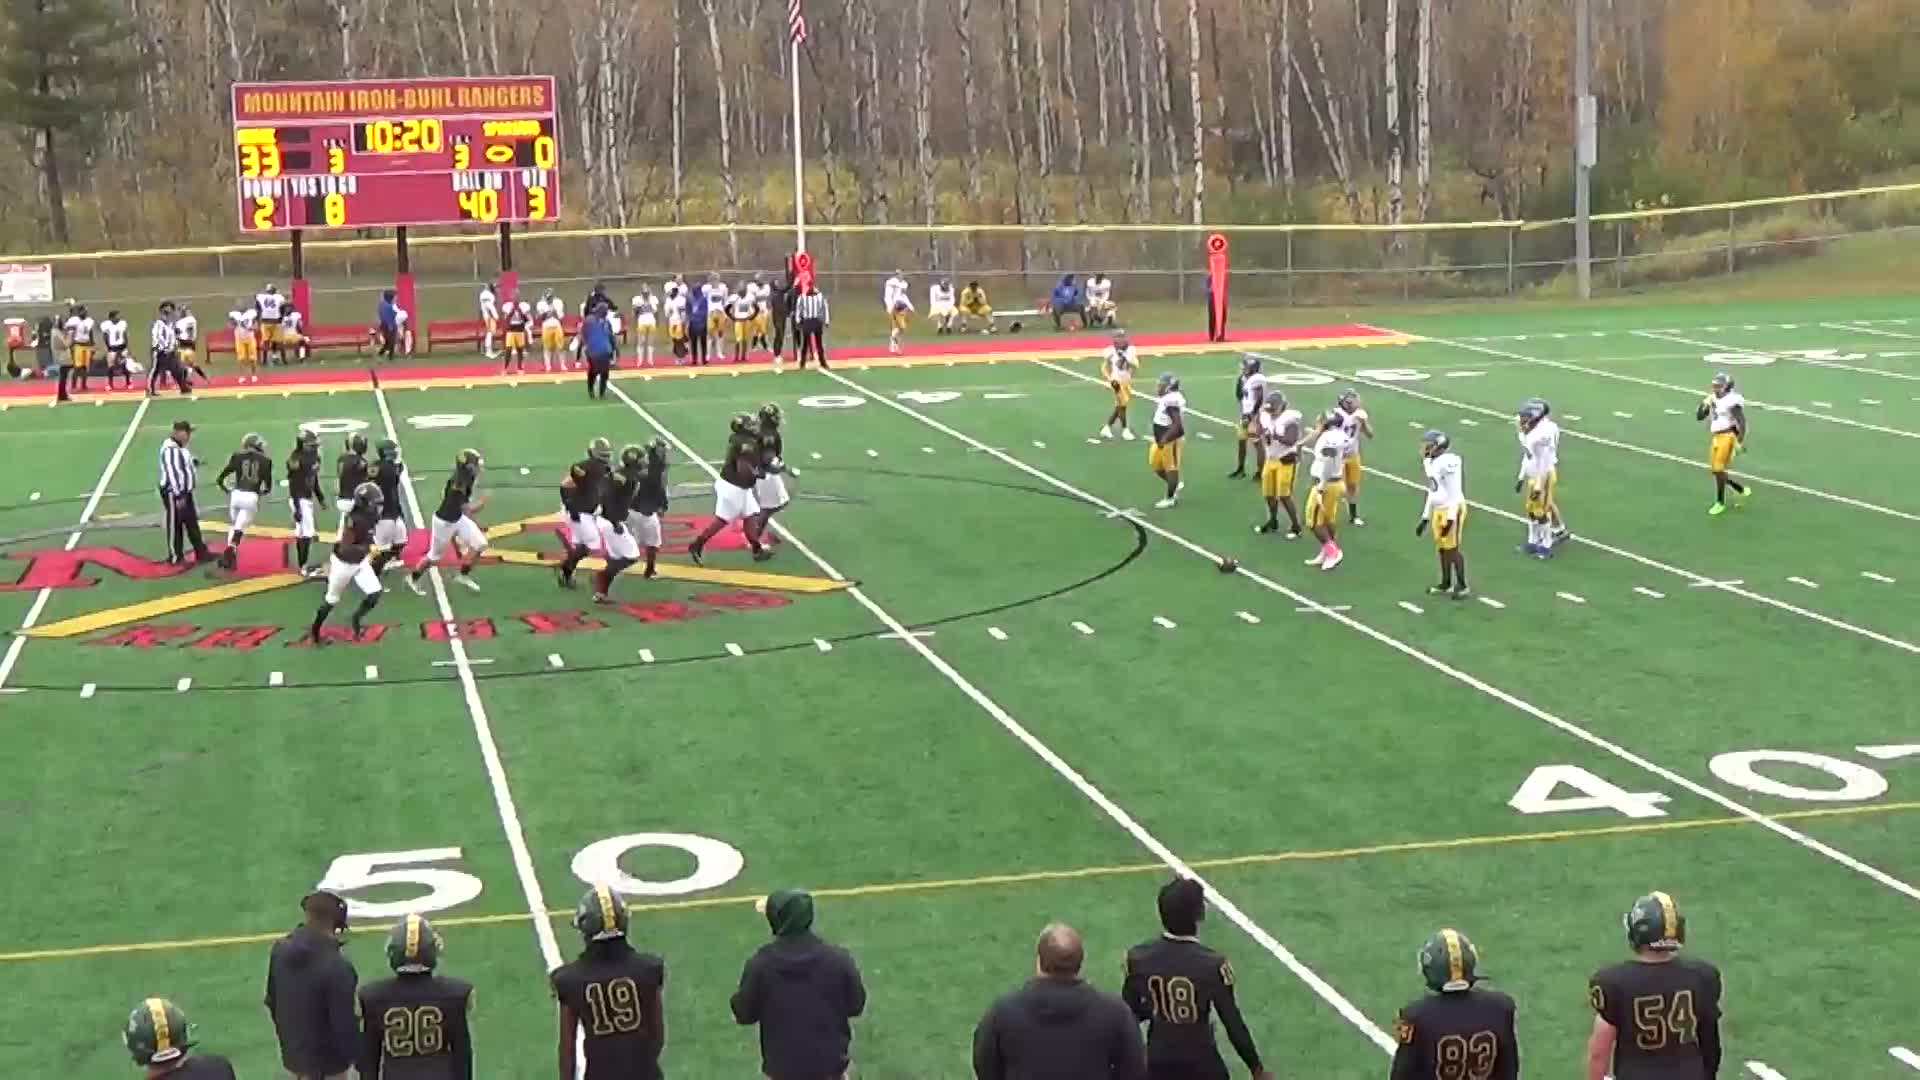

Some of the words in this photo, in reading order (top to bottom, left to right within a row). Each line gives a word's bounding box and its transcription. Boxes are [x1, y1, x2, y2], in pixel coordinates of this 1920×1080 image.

[243, 91, 345, 113] MOUNTAIN
[458, 85, 544, 107] RANGERS
[365, 119, 442, 153] 10:20
[534, 136, 555, 169] 0
[241, 145, 281, 178] 33
[329, 147, 345, 174] 3
[453, 144, 470, 170] 3
[254, 197, 274, 230] 2
[459, 189, 498, 223] 40
[528, 187, 546, 219] 3
[585, 977, 642, 1036] 19
[1149, 975, 1199, 1024] 18
[383, 1006, 444, 1058] 26
[1633, 989, 1699, 1051] 54
[1436, 1030, 1497, 1080] 83
